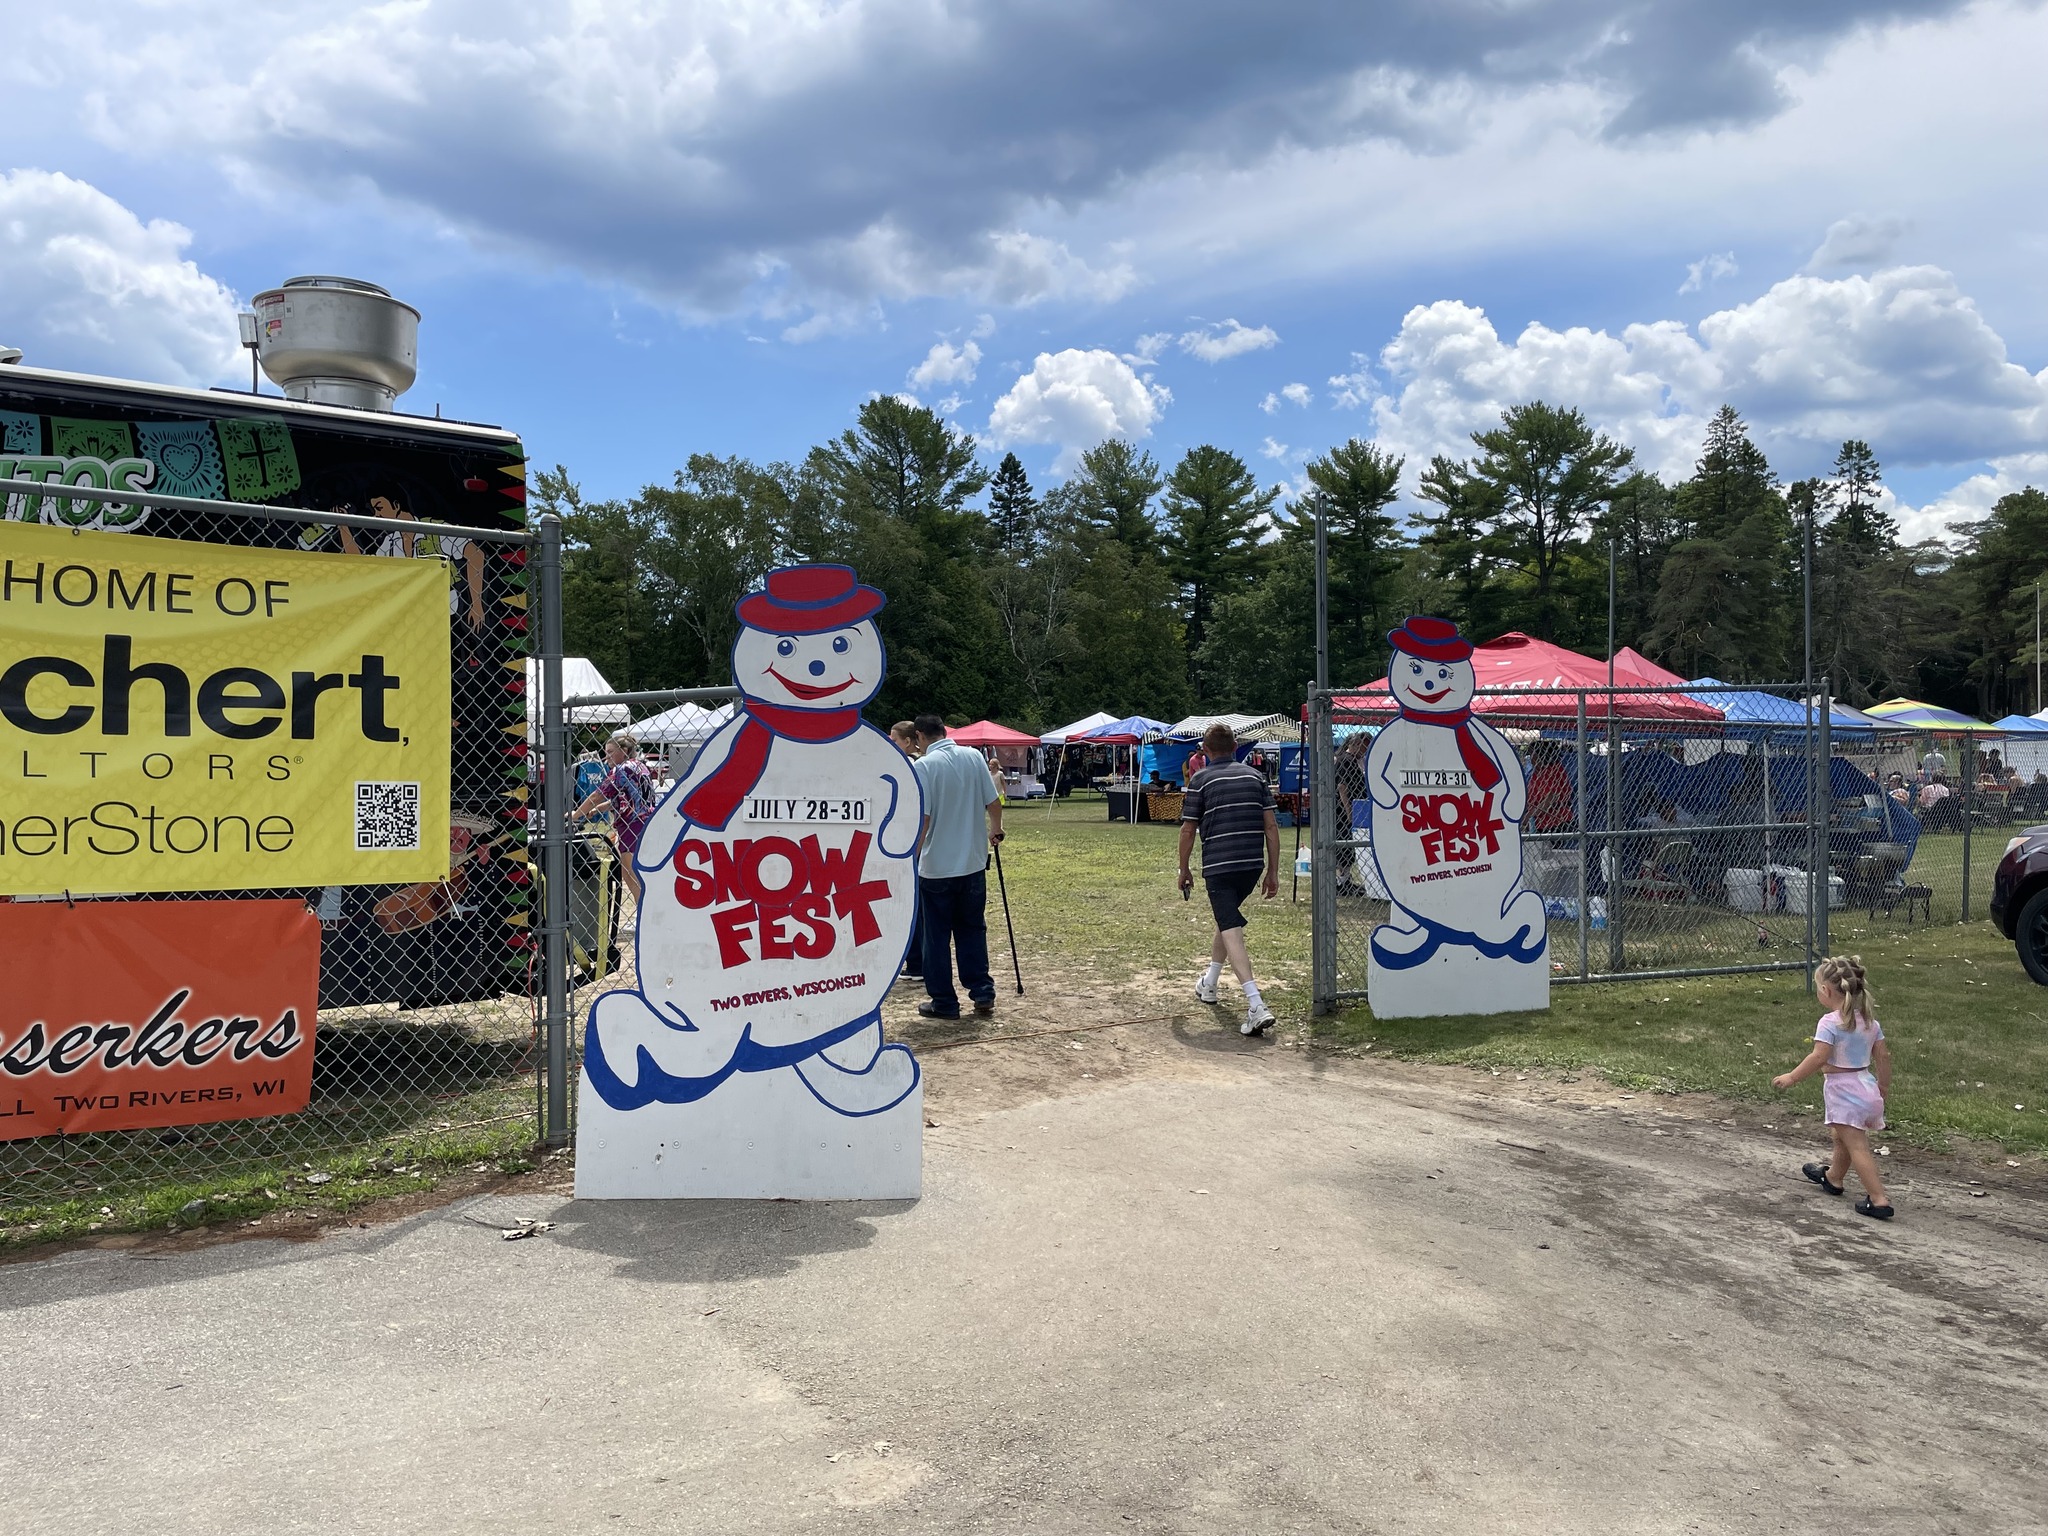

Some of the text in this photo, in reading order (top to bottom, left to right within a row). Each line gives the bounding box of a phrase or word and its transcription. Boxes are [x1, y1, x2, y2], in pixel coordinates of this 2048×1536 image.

[3, 559, 290, 618] HOME OF
[1403, 771, 1467, 786] JULY 28-30
[749, 799, 866, 821] JULY 28-30
[1400, 790, 1495, 834] SNOW
[1420, 818, 1505, 867] FEST
[673, 829, 873, 910] SNOW
[1410, 873, 1427, 884] TWO
[1454, 863, 1492, 877] WISCONSIN
[710, 879, 893, 970] FEST
[710, 972, 866, 1012] TWO RIVERS, WISCONSIN
[54, 1095, 120, 1113] TWO
[128, 1086, 243, 1108] RIVERS,
[252, 1079, 286, 1097] WI
